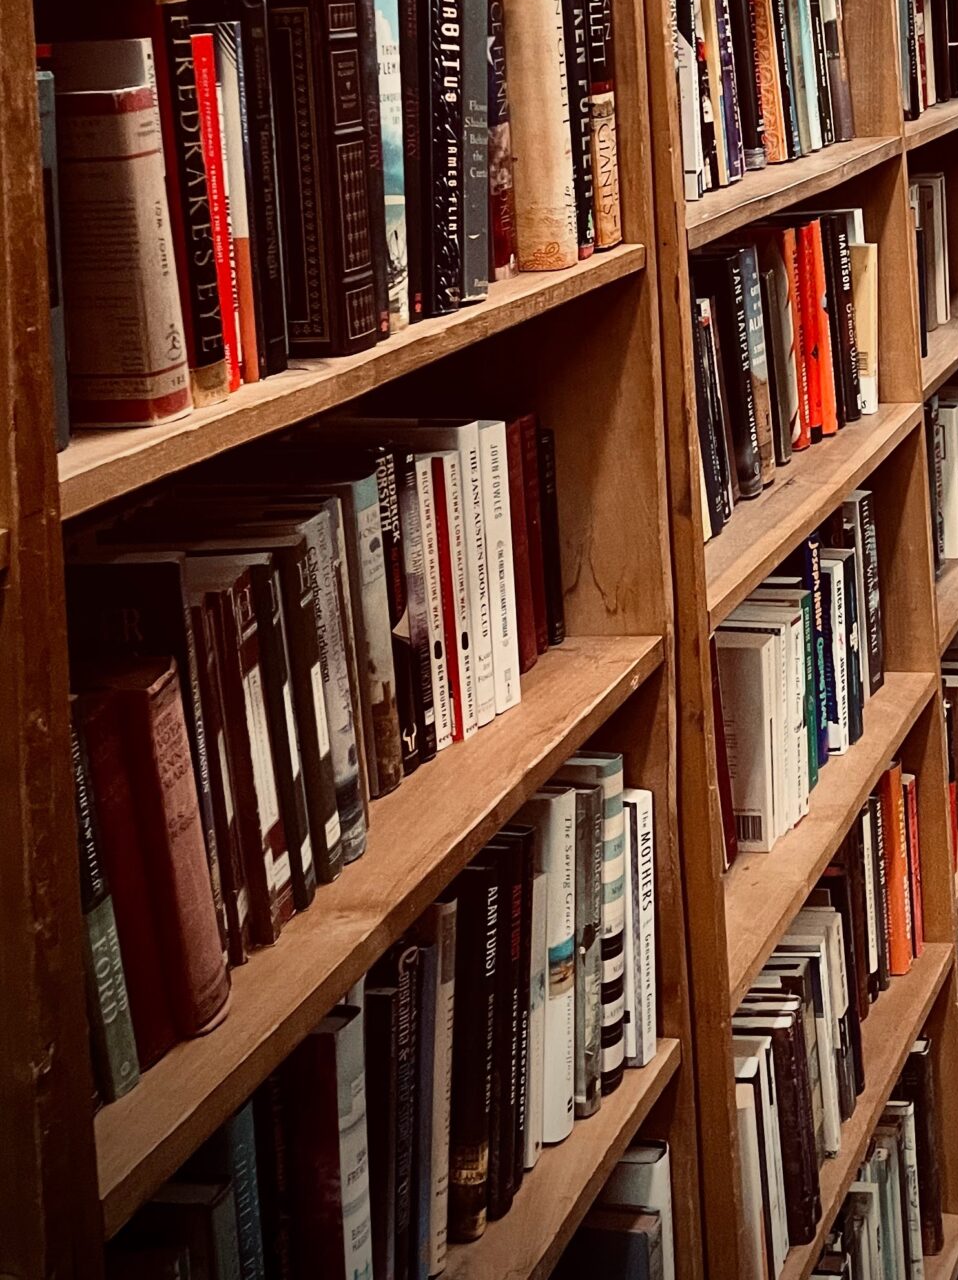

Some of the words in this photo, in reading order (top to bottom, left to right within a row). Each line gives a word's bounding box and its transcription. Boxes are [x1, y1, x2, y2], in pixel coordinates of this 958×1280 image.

[573, 8, 586, 64] KEN
[492, 45, 509, 116] FLYNN
[472, 149, 484, 161] the
[578, 79, 594, 199] FOLLETT
[446, 138, 459, 187] JAMES
[597, 122, 614, 215] GIANTS
[210, 170, 219, 200] TENDER
[155, 199, 163, 228] TOM
[214, 213, 222, 232] THE
[447, 191, 459, 241] FLINT
[157, 235, 169, 277] JONES
[216, 234, 225, 264] NIGHT
[731, 267, 742, 305] JANE
[838, 233, 850, 292] HARRISON
[846, 302, 856, 346] DEMON
[196, 282, 223, 353] EYE
[736, 309, 750, 372] HARPER
[748, 394, 759, 454] SURVIVORS
[449, 463, 457, 488] BILLY
[469, 447, 477, 470] THE
[489, 443, 499, 473] JOHN
[375, 457, 392, 532] FORSYTH
[384, 454, 401, 543] FREDERICK
[420, 470, 429, 497] BILLY
[452, 490, 460, 519] LYNN'S
[470, 473, 480, 504] JANE
[491, 475, 502, 520] FOWLES
[424, 498, 432, 528] LYNN'S
[472, 507, 483, 558] AUSTEN
[427, 531, 435, 556] LONG
[808, 540, 821, 589] Joseph
[429, 558, 438, 604] HALFTIME
[457, 549, 465, 593] HALFTIME
[476, 563, 487, 605] BOOK
[859, 499, 872, 556] HELPRIN
[869, 623, 878, 654] TALE
[432, 605, 441, 632] WALK
[460, 595, 468, 621] WALK
[813, 589, 823, 632] Heller
[835, 578, 845, 625] CATCH-22
[308, 565, 323, 624] Northcote
[317, 624, 331, 683] Parkinson
[480, 609, 490, 639] CLUB
[436, 664, 444, 683] BEN
[837, 656, 847, 691] JOSEPH
[438, 686, 449, 730] FOUNTAIN
[465, 676, 475, 719] FOUNTAIN
[840, 694, 848, 729] HELLER
[193, 718, 209, 794] COMPANION
[78, 766, 102, 894] SPORTSWRITER
[564, 816, 572, 839] The
[641, 810, 649, 829] The
[875, 801, 885, 858] NOWHERE
[562, 841, 572, 891] Saving
[639, 831, 653, 913] MOTHERS
[879, 858, 887, 886] MAN
[487, 885, 499, 927] ALAN
[512, 883, 522, 916] ALAN
[564, 893, 572, 937] Graces
[485, 924, 498, 978] FURST
[643, 932, 652, 989] Genevieve
[91, 936, 118, 1024] FORD
[645, 991, 653, 1035] Gannon
[510, 1056, 518, 1105] BALKANS
[516, 1009, 528, 1131] CORRESPONDENT
